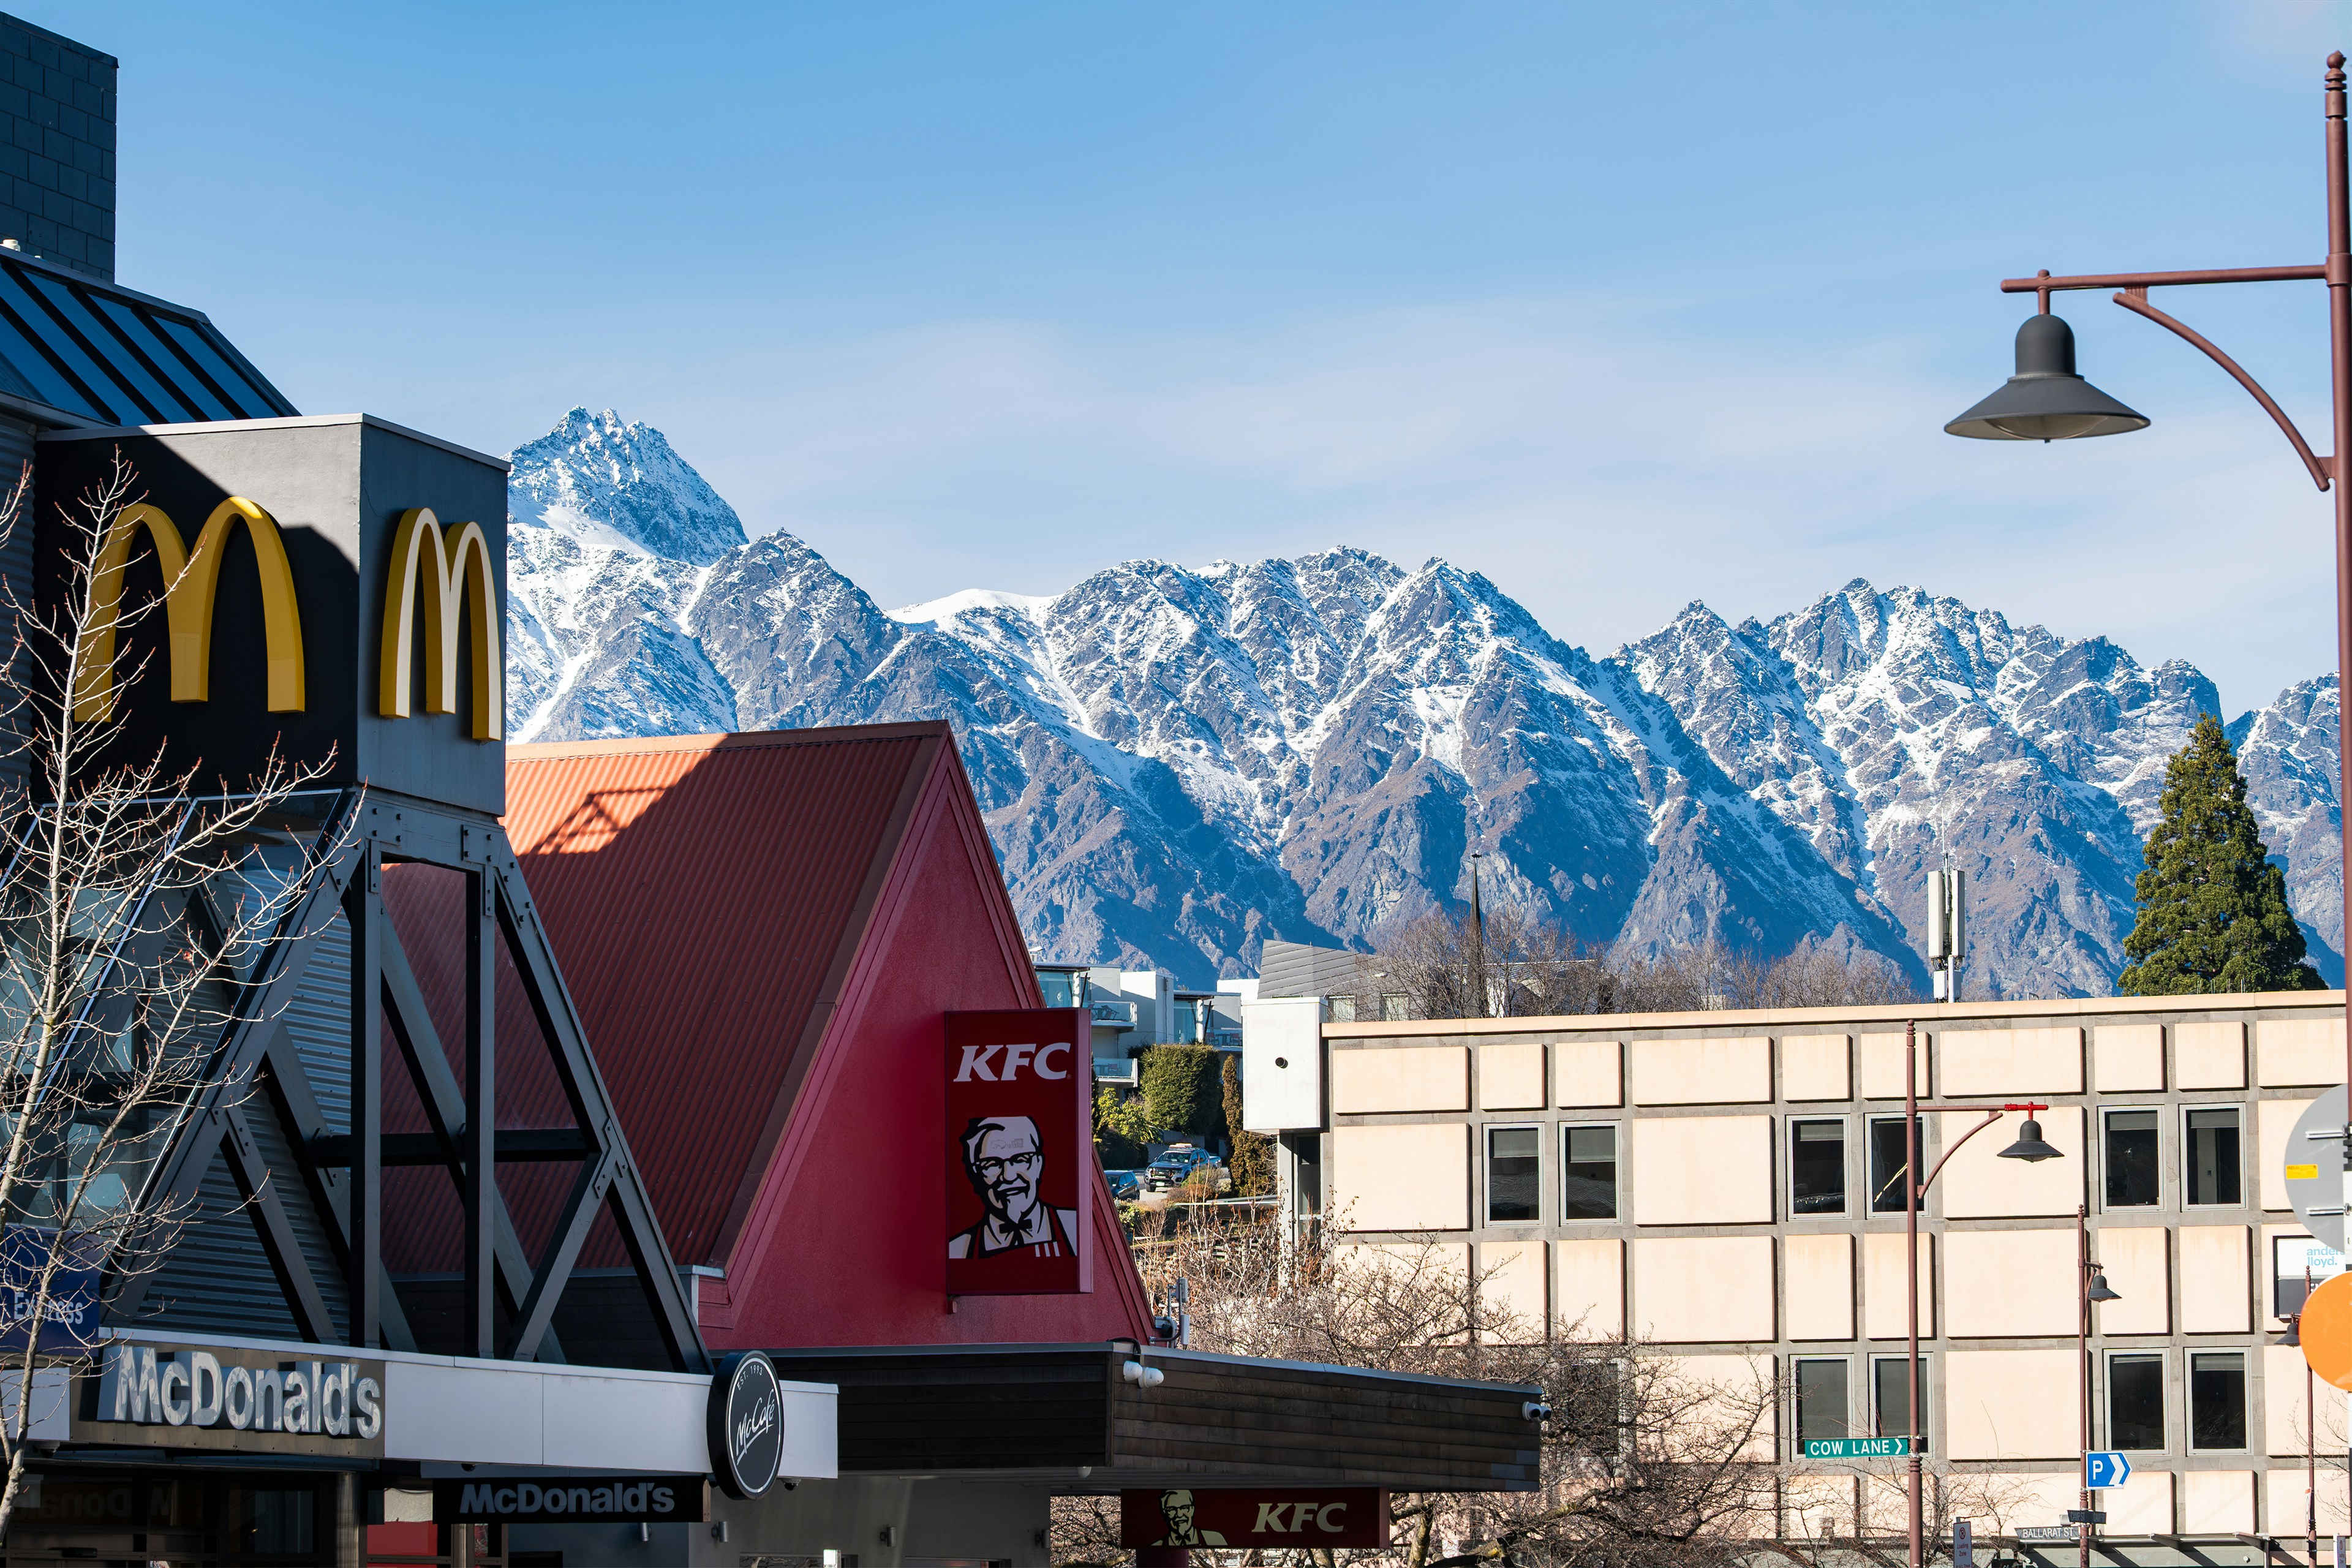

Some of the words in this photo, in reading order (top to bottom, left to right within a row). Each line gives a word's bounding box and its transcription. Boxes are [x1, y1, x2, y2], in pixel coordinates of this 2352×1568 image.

[953, 1042, 1071, 1082] KFC
[2307, 1256, 2338, 1268] lloyd.
[13, 1291, 84, 1325] Exress
[113, 1346, 381, 1439] McDonald's
[737, 1370, 749, 1391] EST.
[750, 1365, 763, 1376] 1993
[736, 1388, 775, 1455] McCafé
[1810, 1441, 1844, 1456] COW
[1852, 1439, 1890, 1455] LANE
[2092, 1460, 2103, 1480] P
[459, 1483, 674, 1513] McDonald's
[1251, 1502, 1348, 1532] KFC
[2022, 1528, 2062, 1538] BALLARAT
[2064, 1527, 2075, 1537] ST
